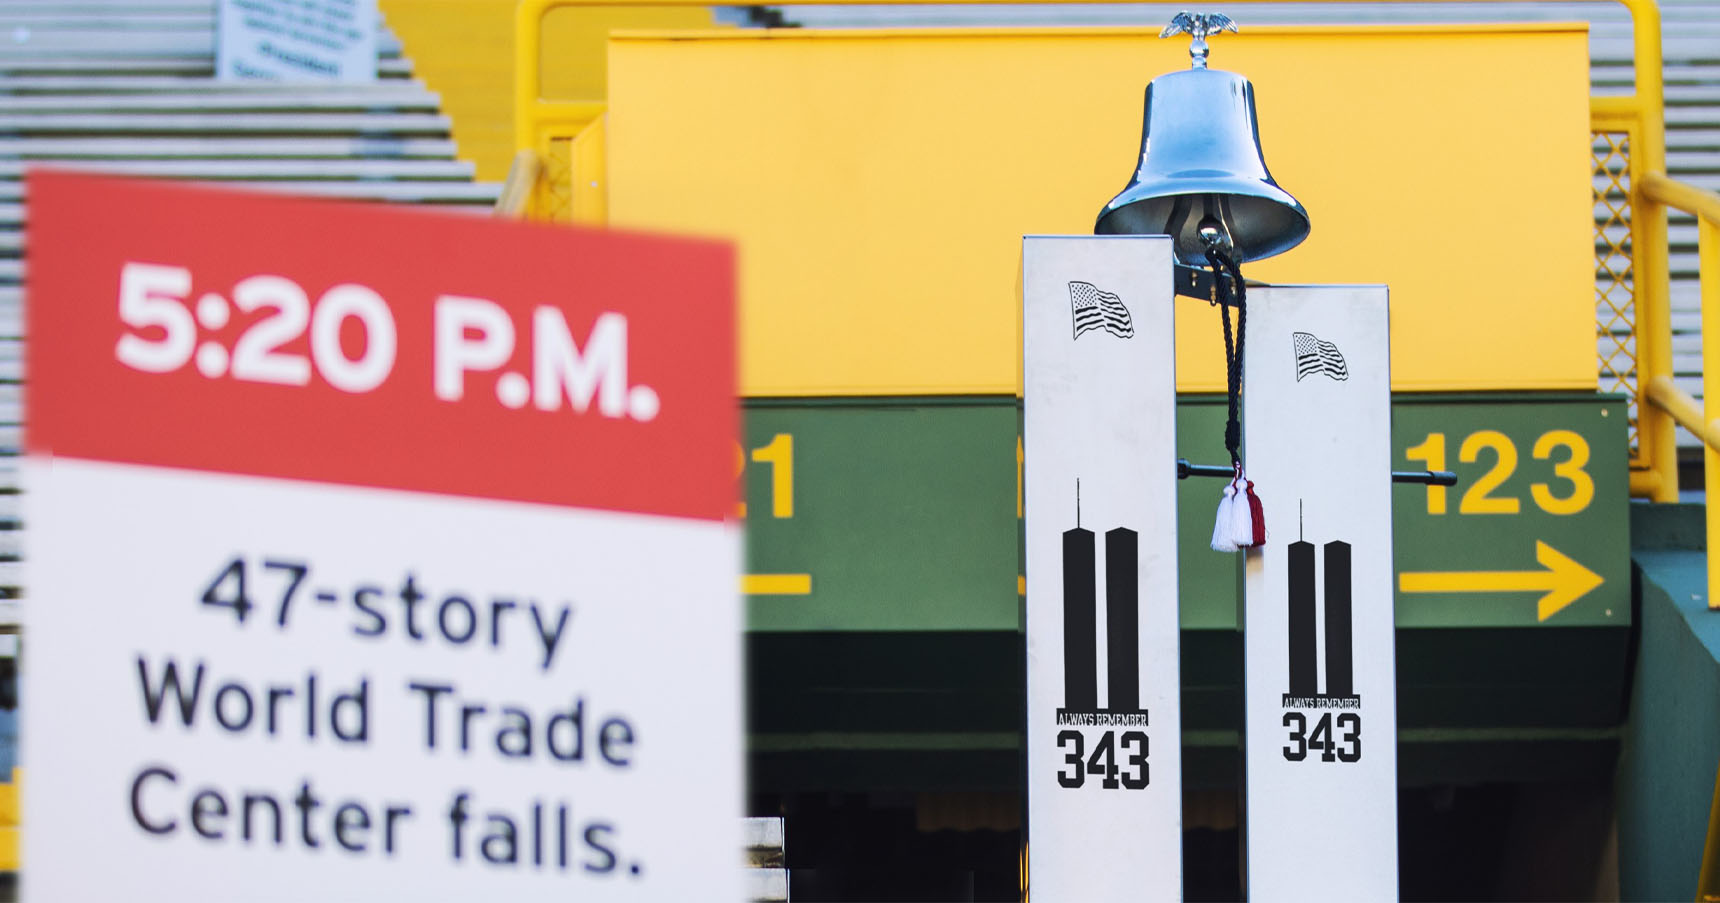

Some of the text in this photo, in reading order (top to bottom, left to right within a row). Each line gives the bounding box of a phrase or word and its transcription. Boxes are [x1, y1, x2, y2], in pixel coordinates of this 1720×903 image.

[115, 262, 661, 423] 5:20 P.M.
[1405, 429, 1595, 515] 123
[199, 555, 574, 672] 47-story
[134, 654, 639, 770] World Trade
[1058, 713, 1147, 726] ALWAYS REMEMBER
[1282, 711, 1362, 763] 343
[1284, 697, 1359, 709] ALWAYS REMEMBER
[1057, 729, 1150, 790] 343
[127, 763, 643, 878] Center falls.
